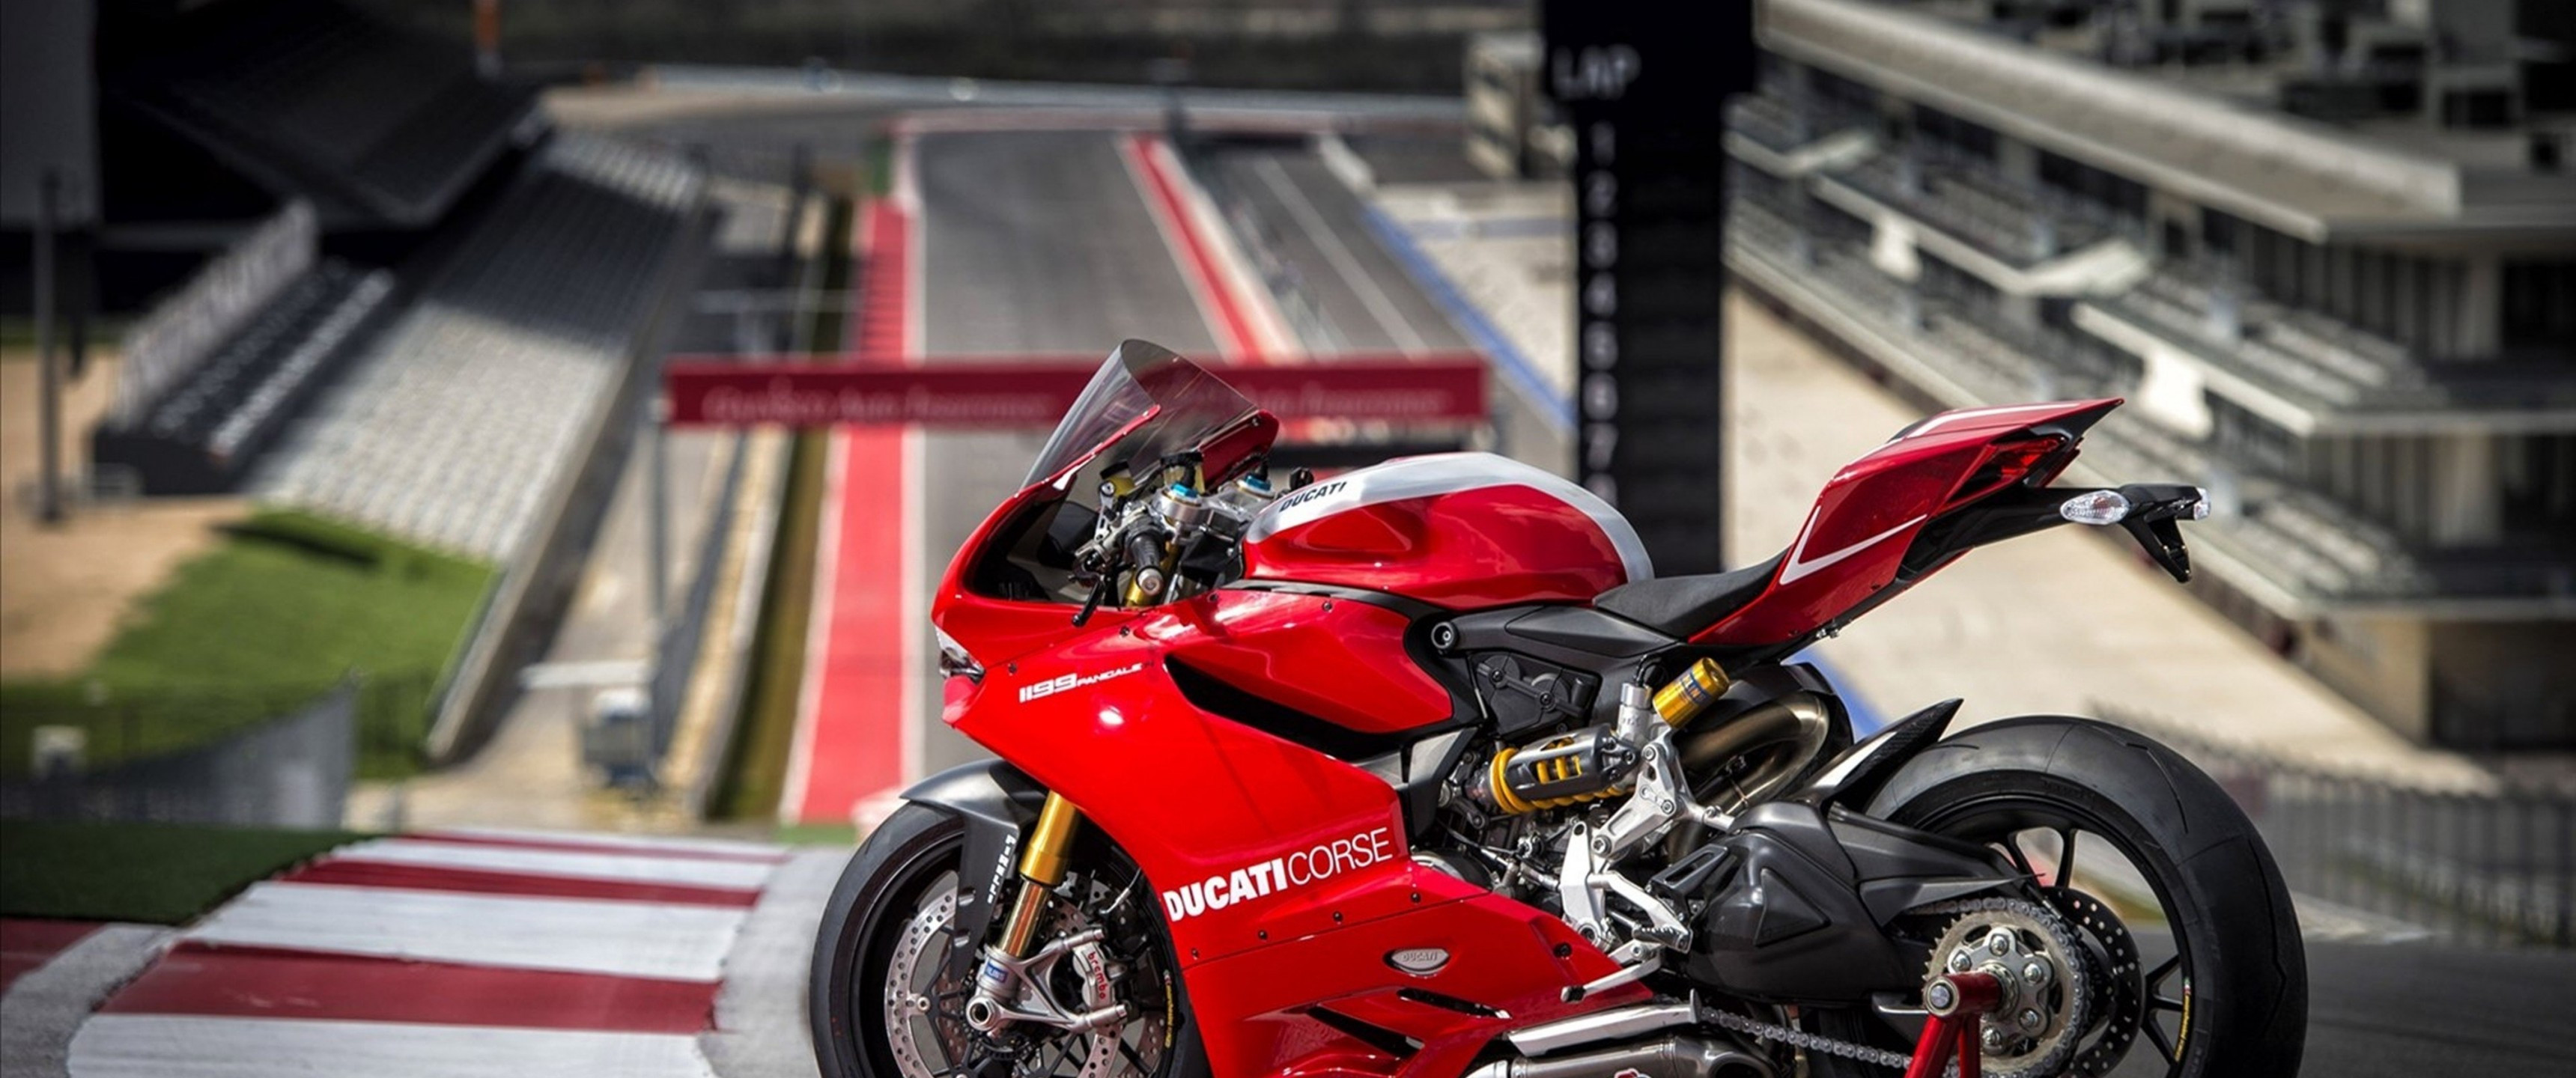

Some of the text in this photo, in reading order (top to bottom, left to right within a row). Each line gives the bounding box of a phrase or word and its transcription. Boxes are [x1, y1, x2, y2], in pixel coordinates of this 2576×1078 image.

[1553, 45, 1641, 100] LAP
[1591, 122, 1615, 164] 1
[1585, 171, 1617, 215] 2
[1585, 222, 1617, 268] 3
[1584, 423, 1618, 470] 7
[1279, 481, 1347, 513] DUCATI
[1019, 673, 1078, 703] 1199
[1162, 827, 1393, 922] DUCATI CORSE
[1087, 951, 1108, 999] brembo
